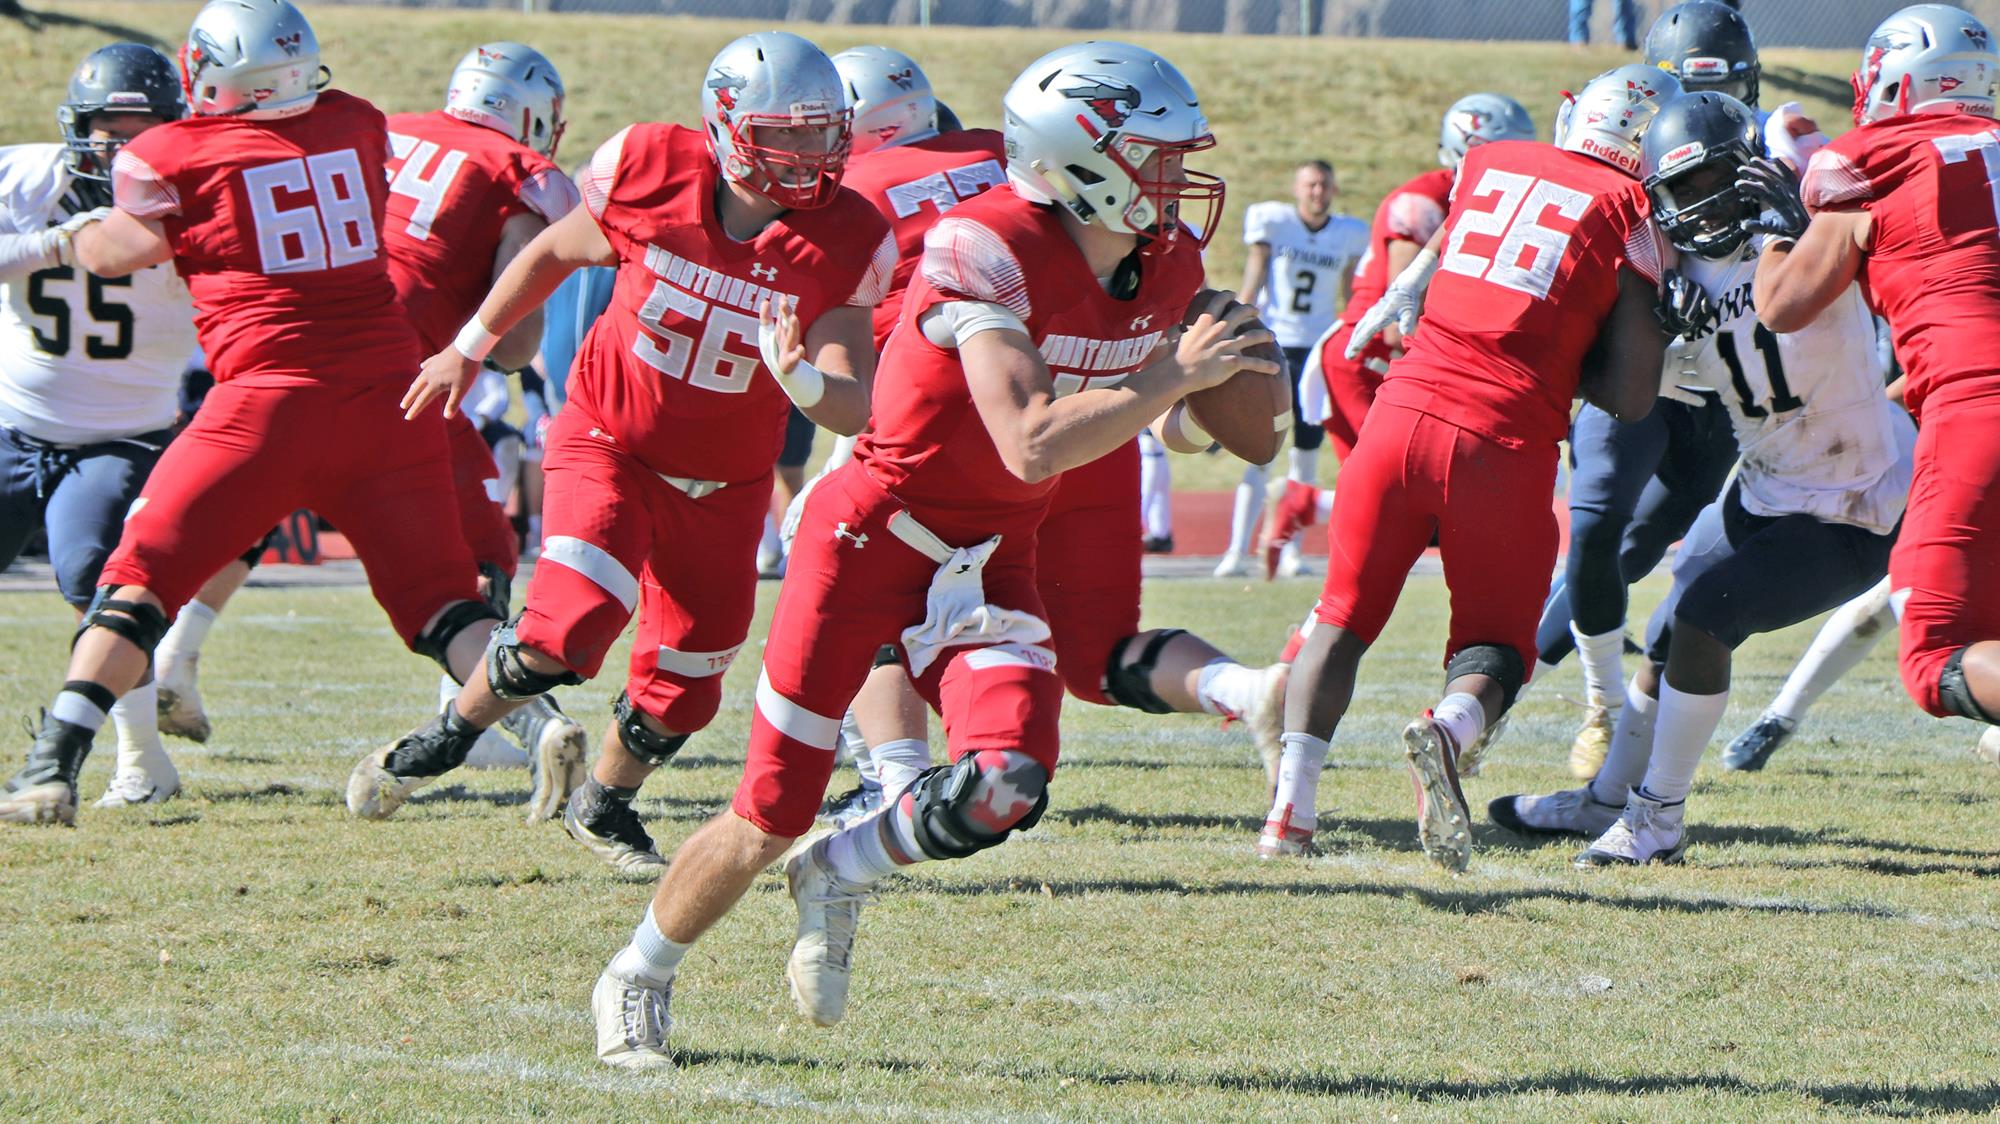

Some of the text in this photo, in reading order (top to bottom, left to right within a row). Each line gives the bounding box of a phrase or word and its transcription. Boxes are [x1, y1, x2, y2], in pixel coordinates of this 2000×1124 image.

[1581, 138, 1641, 173] Riddell
[1931, 129, 2000, 241] 7
[242, 148, 378, 274] 68
[1441, 168, 1594, 301] 26
[28, 264, 134, 359] 55
[632, 279, 760, 393] 56
[1292, 269, 1317, 312] 2
[1716, 321, 1804, 417] 11
